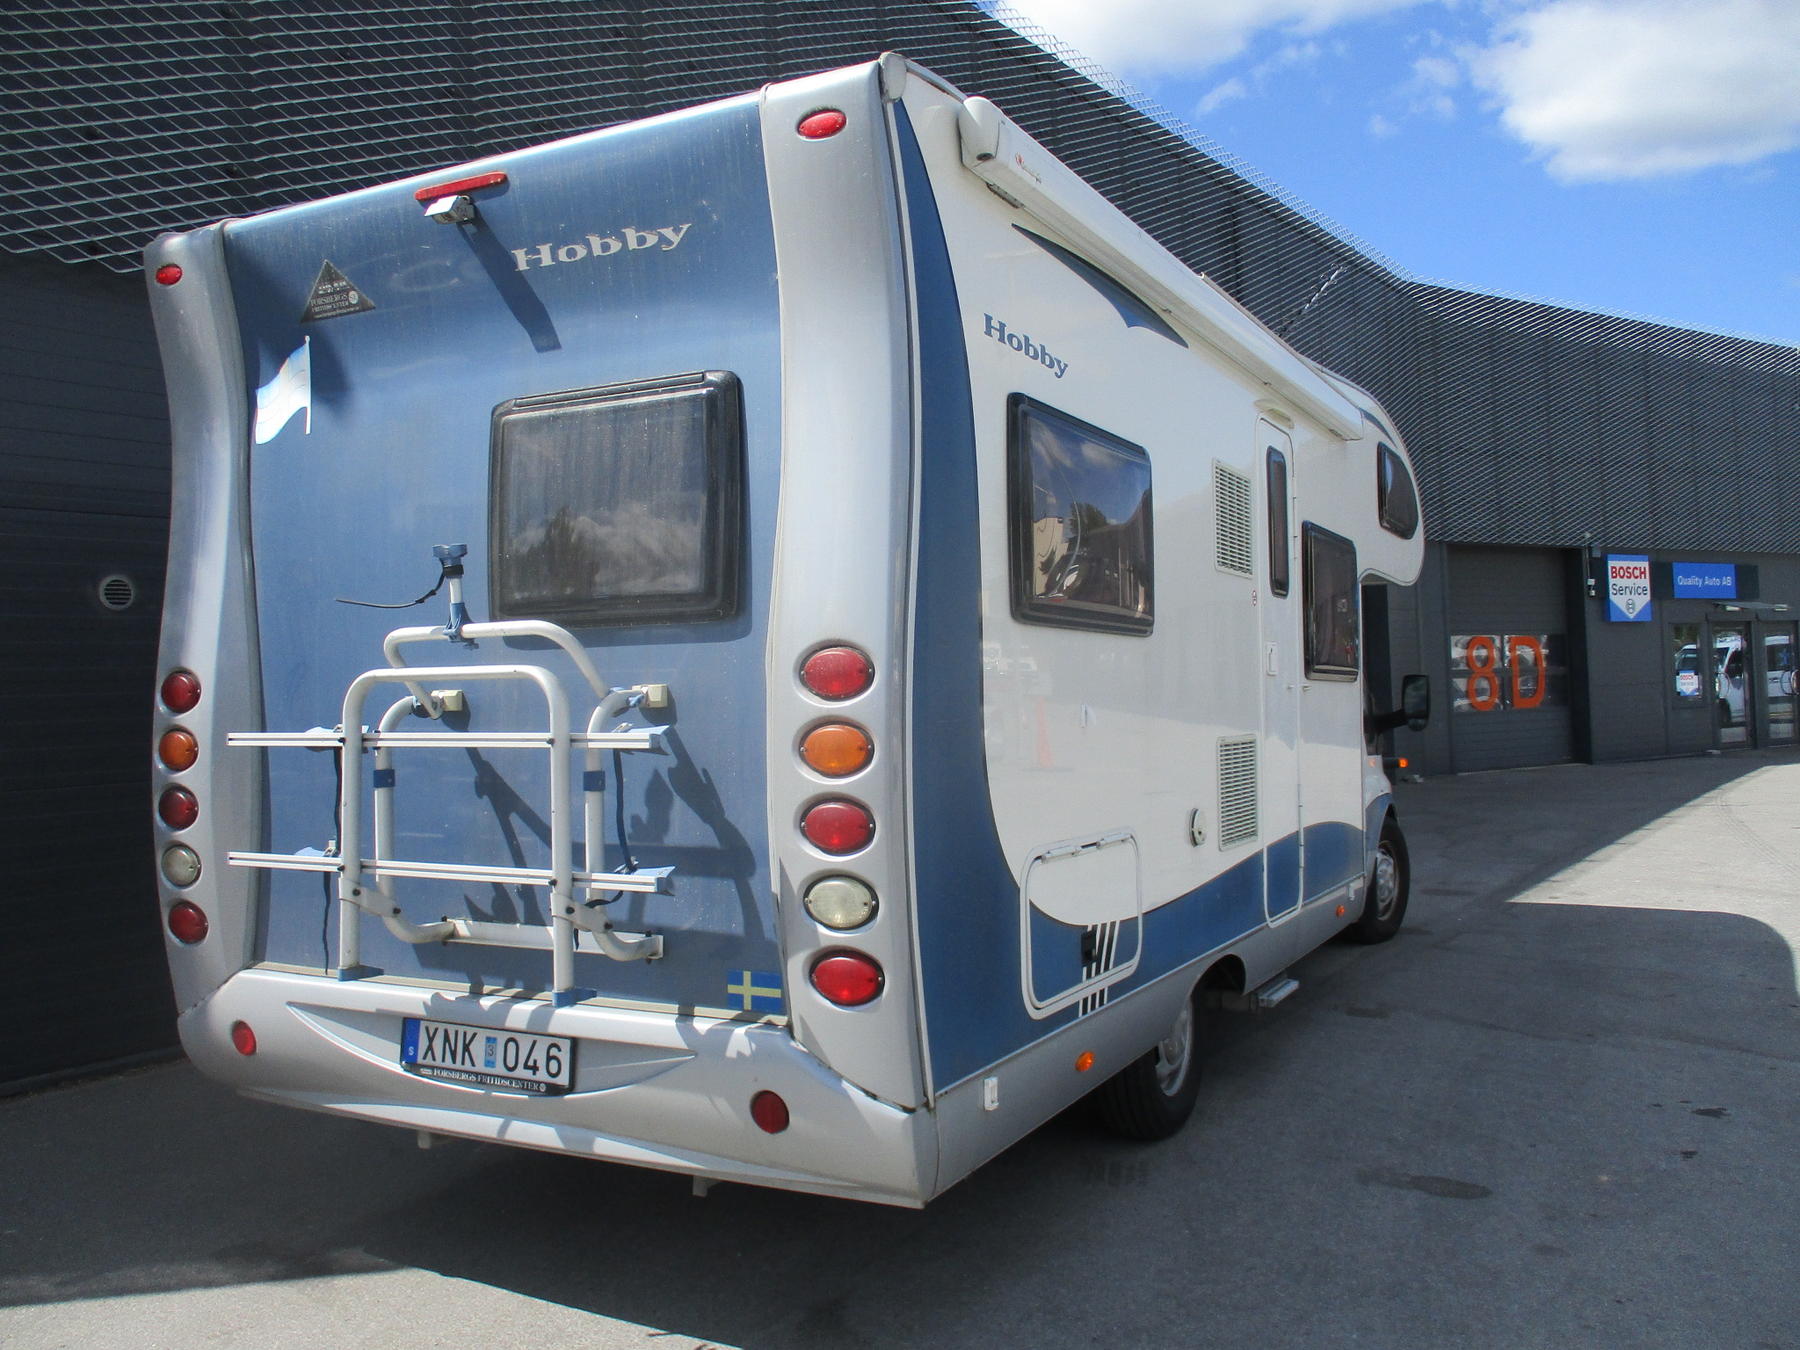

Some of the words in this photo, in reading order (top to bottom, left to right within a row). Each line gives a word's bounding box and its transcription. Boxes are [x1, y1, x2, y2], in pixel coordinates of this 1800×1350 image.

[511, 223, 692, 272] Hobby
[983, 312, 1069, 379] Hobby
[1610, 566, 1647, 579] BOSCH
[1677, 575, 1702, 588] Quality
[1704, 576, 1721, 586] Auto
[1722, 576, 1732, 586] AB
[1611, 583, 1648, 596] Service
[408, 1047, 414, 1056] S
[422, 1026, 478, 1067] XNK
[503, 1037, 562, 1079] 046
[433, 1068, 477, 1082] FORSBERGS
[478, 1074, 540, 1091] FRITIDSCENTER
